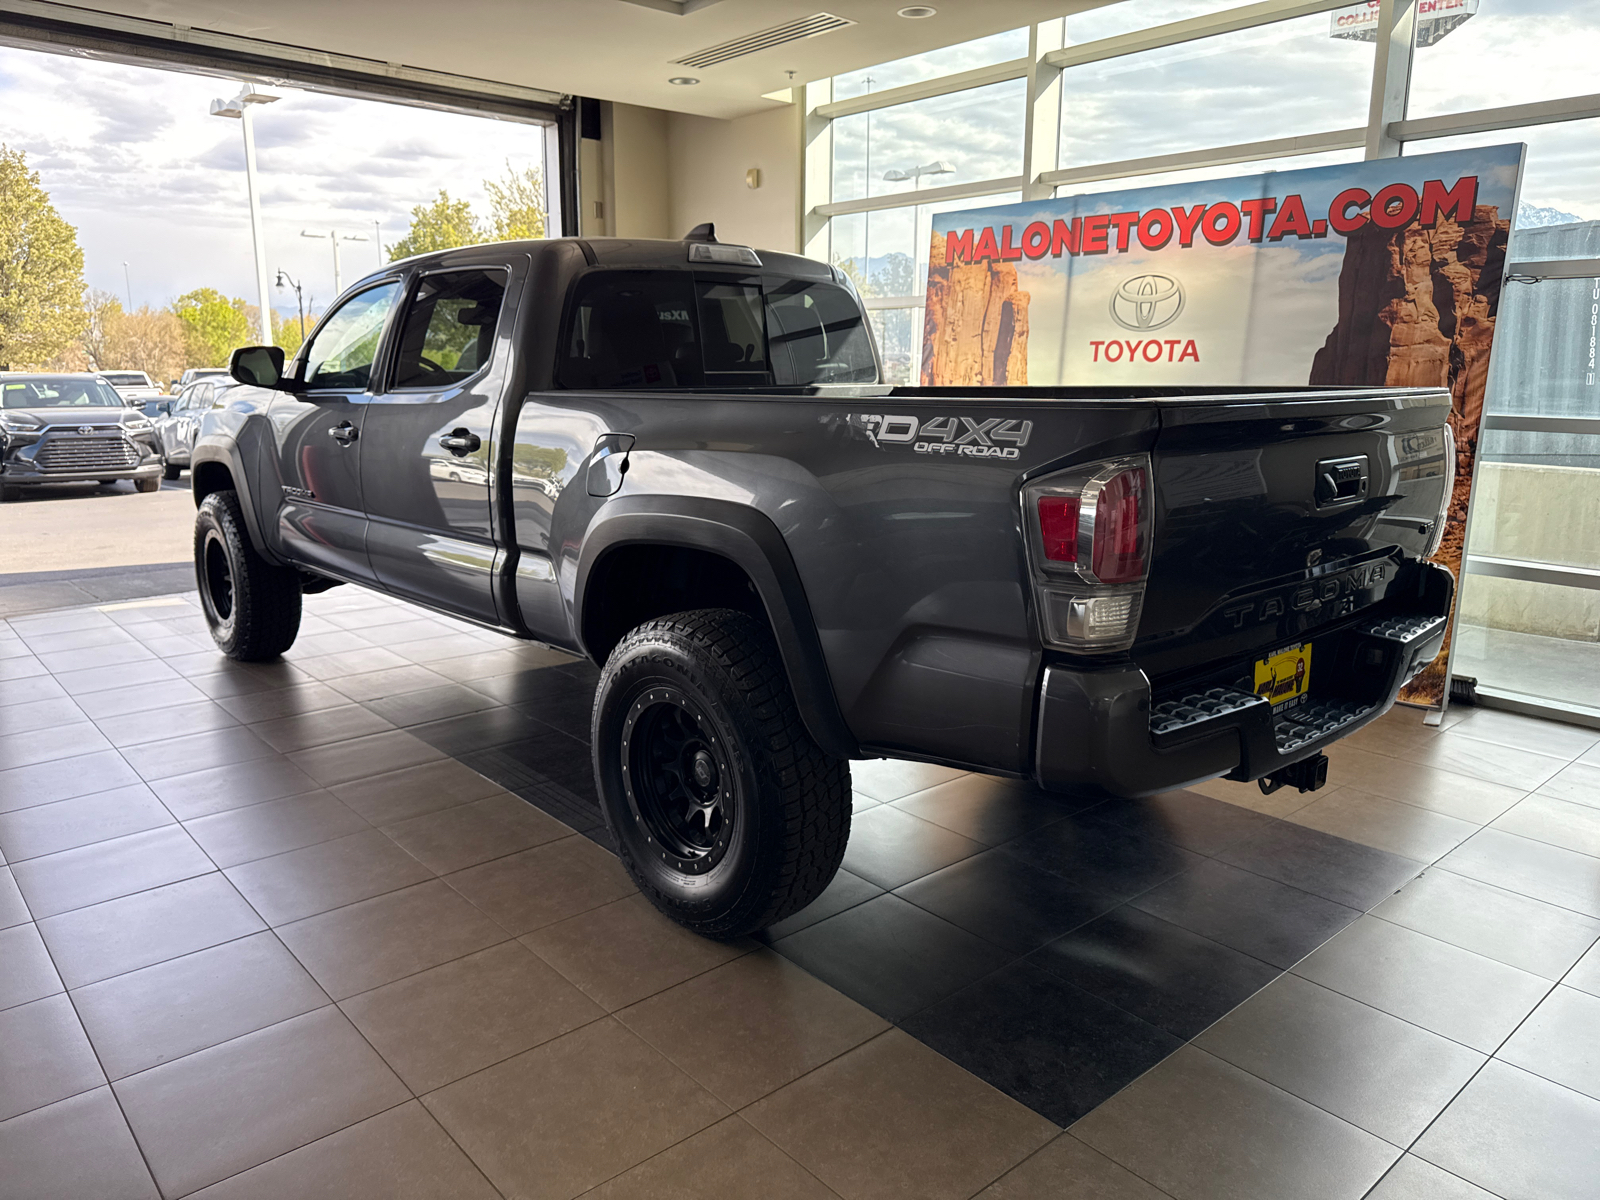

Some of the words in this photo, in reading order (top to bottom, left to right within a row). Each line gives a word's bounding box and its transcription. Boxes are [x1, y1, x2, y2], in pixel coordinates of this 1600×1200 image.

[1336, 10, 1379, 26] COLLIS
[1418, 0, 1464, 13] ENTER
[945, 176, 1479, 264] MALONETOYOTA.COM
[1089, 339, 1200, 363] TOYOTA
[919, 416, 1034, 447] 4X4
[913, 441, 960, 455] OFF
[957, 444, 1021, 460] ROAD
[1337, 466, 1361, 479] TOYOTA
[1224, 563, 1386, 629] TACOMA
[609, 653, 708, 697] PATAGONIA
[1297, 662, 1304, 672] 32
[1289, 697, 1299, 709] EASY
